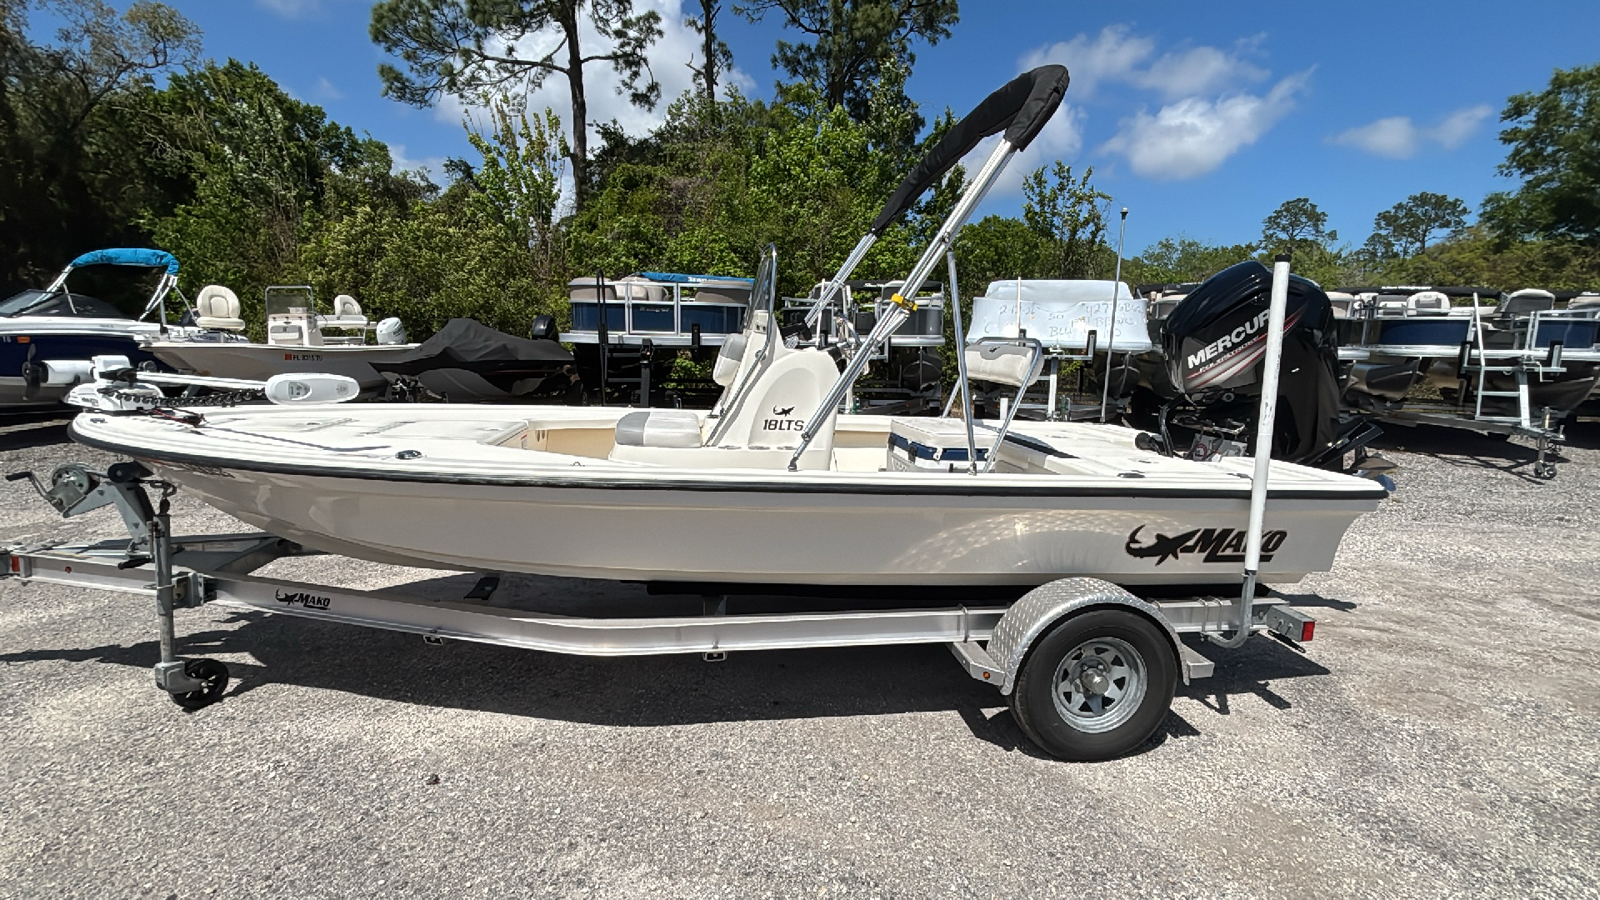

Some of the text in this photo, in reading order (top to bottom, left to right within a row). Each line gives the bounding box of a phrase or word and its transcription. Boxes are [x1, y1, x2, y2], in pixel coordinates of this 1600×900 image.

[1187, 308, 1271, 369] MERCUR
[763, 419, 805, 431] 18LTS
[294, 592, 331, 610] MAKO
